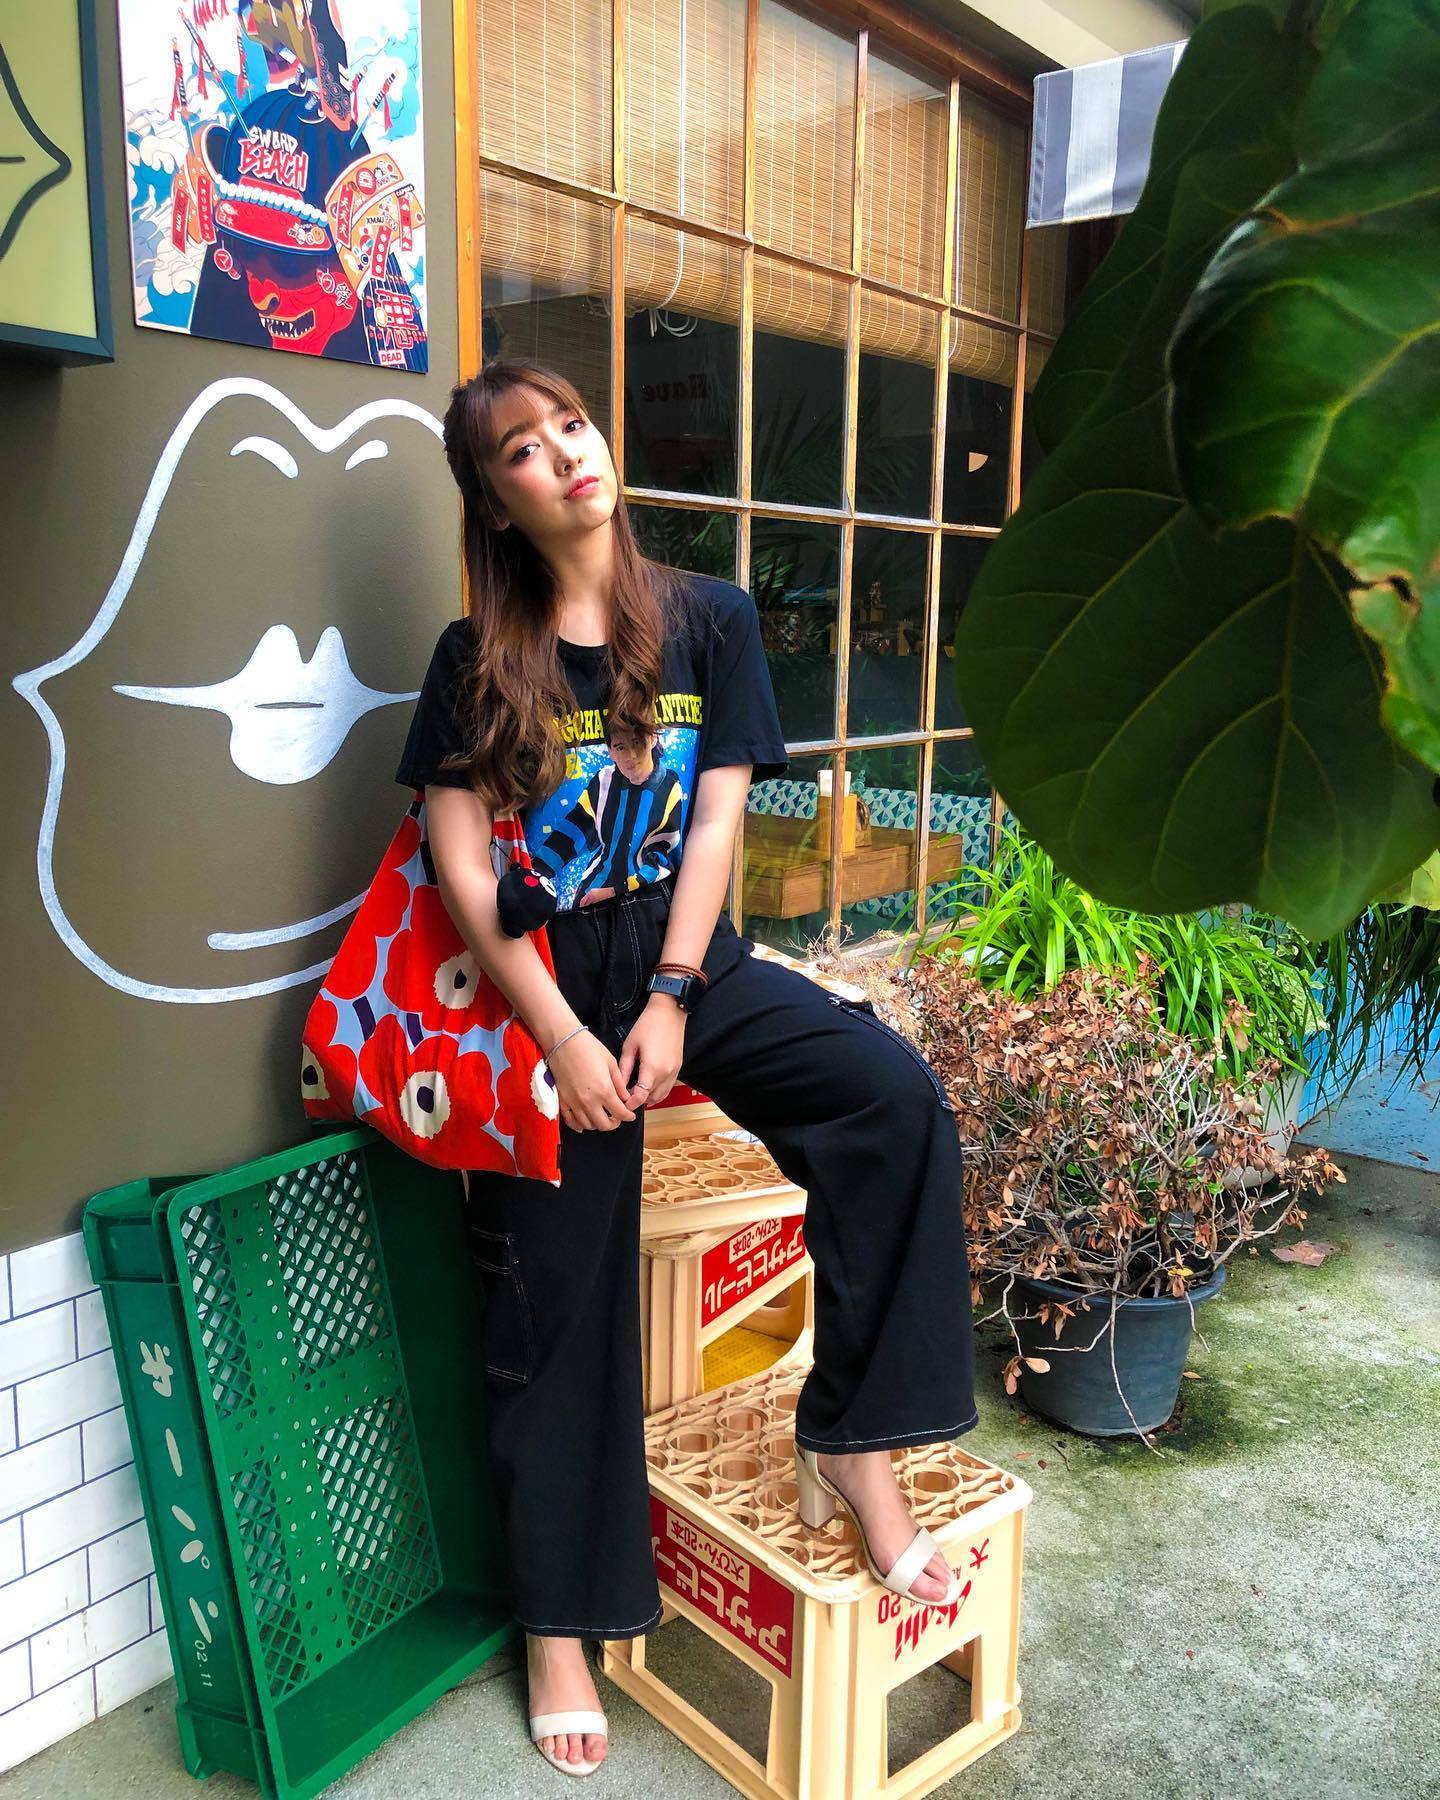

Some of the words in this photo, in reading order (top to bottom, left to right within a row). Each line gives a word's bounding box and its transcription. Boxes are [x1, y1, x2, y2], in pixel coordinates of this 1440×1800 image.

[238, 139, 309, 192] BEACH
[381, 352, 403, 363] DEAD
[704, 1224, 804, 1314] アサヒビール
[877, 1594, 902, 1625] 20
[194, 1639, 214, 1688] 02.11
